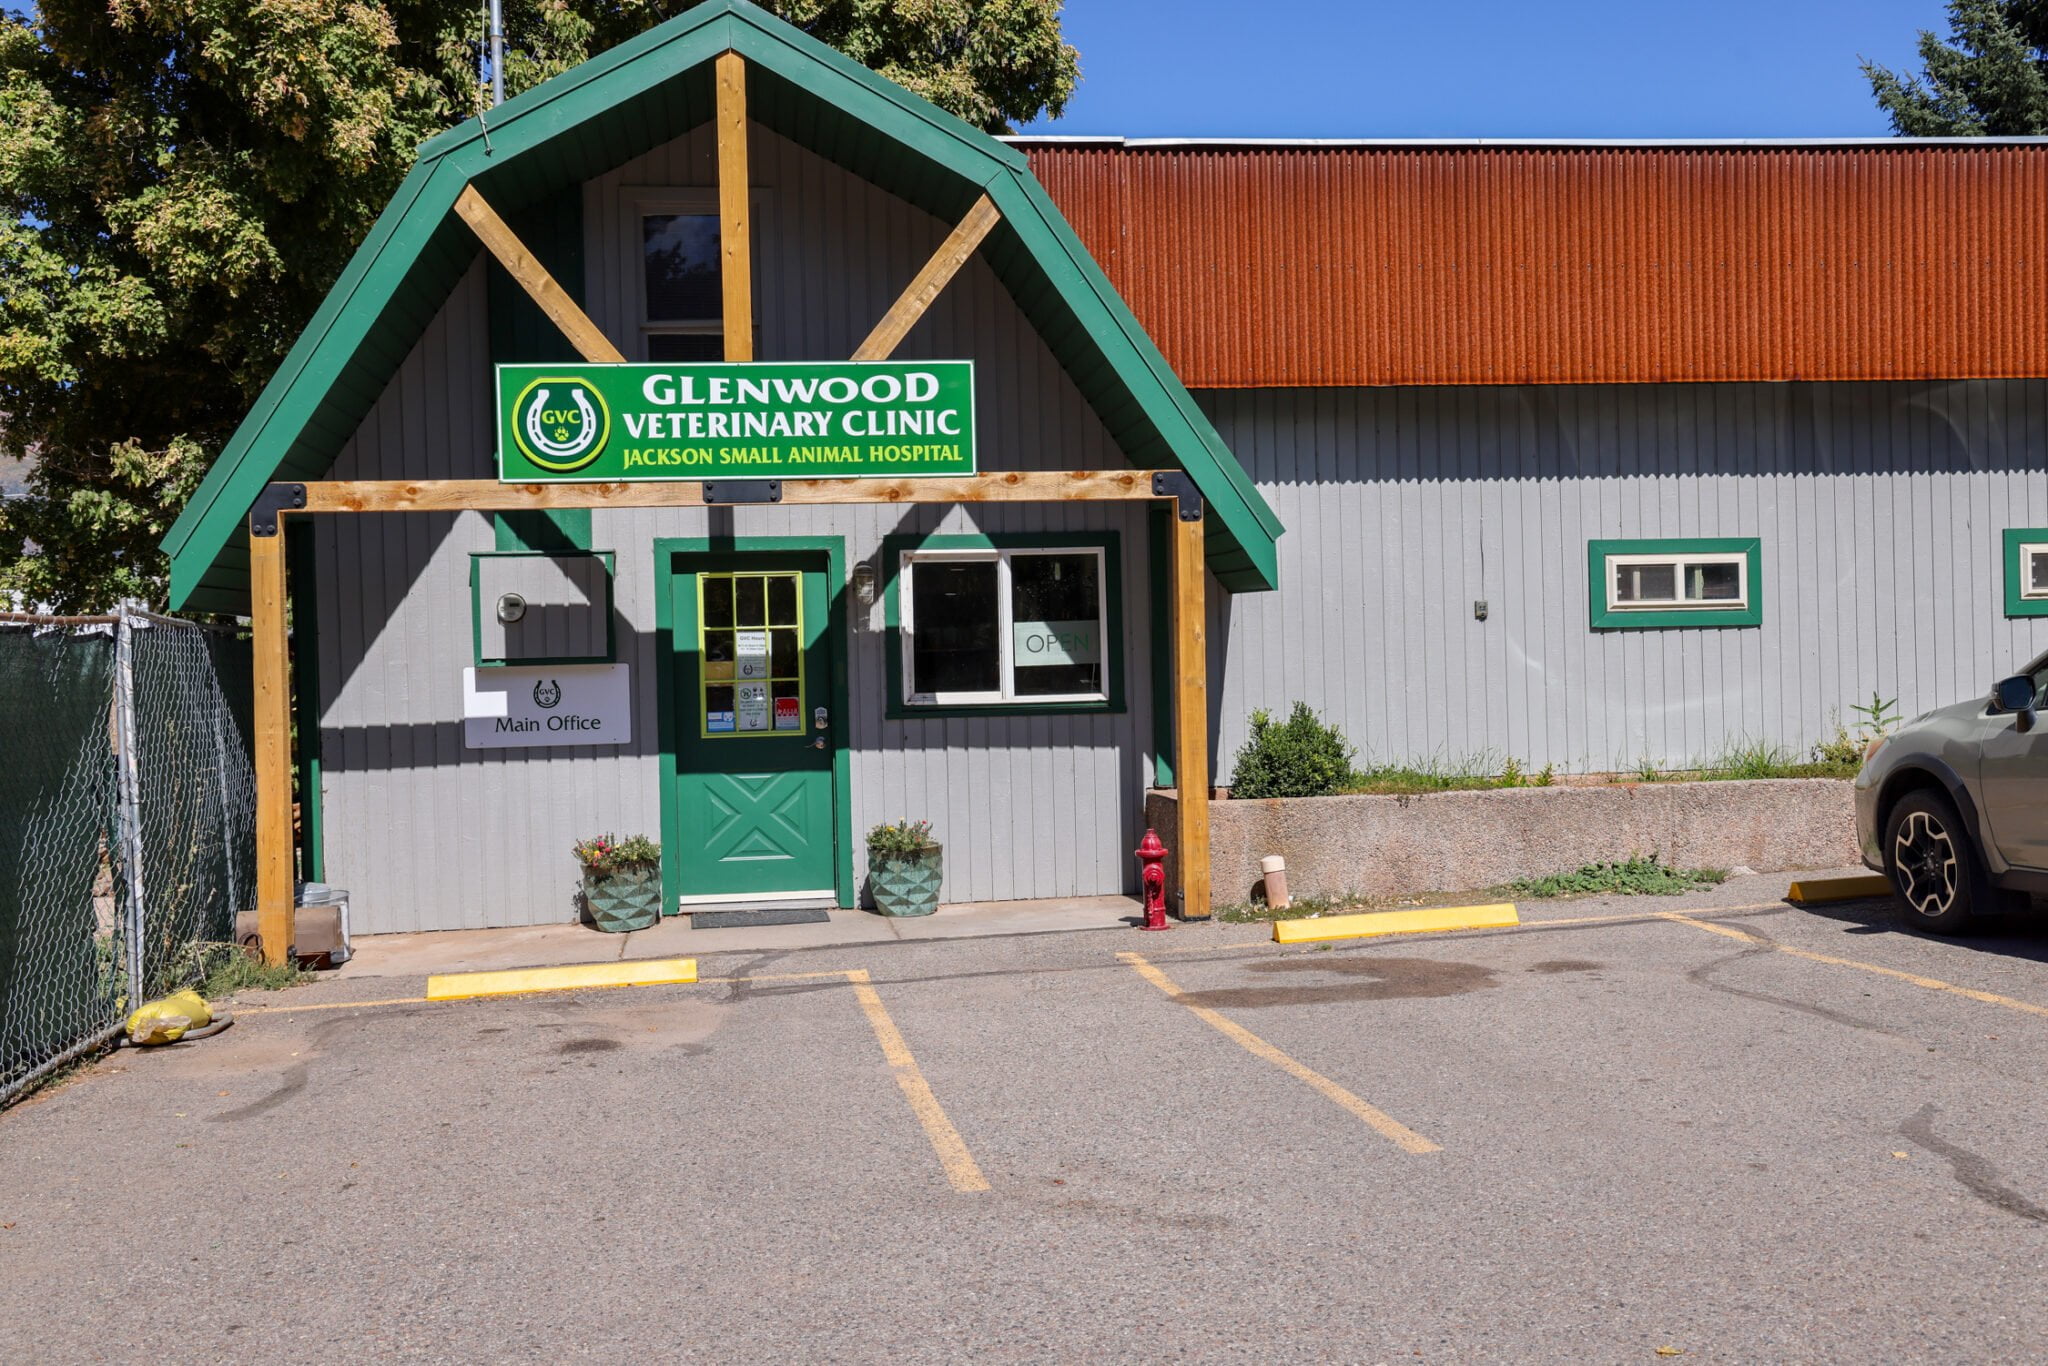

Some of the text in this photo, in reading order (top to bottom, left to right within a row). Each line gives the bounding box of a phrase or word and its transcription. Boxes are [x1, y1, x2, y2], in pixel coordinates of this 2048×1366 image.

[642, 372, 939, 405] GLENWOOD
[541, 409, 581, 425] GVC
[622, 408, 961, 440] VETERINARY CLINIC
[623, 444, 963, 470] JACKSON SMALL ANIMAL HOSPITAL
[1026, 634, 1089, 653] OPEN
[495, 715, 602, 733] Main Office
